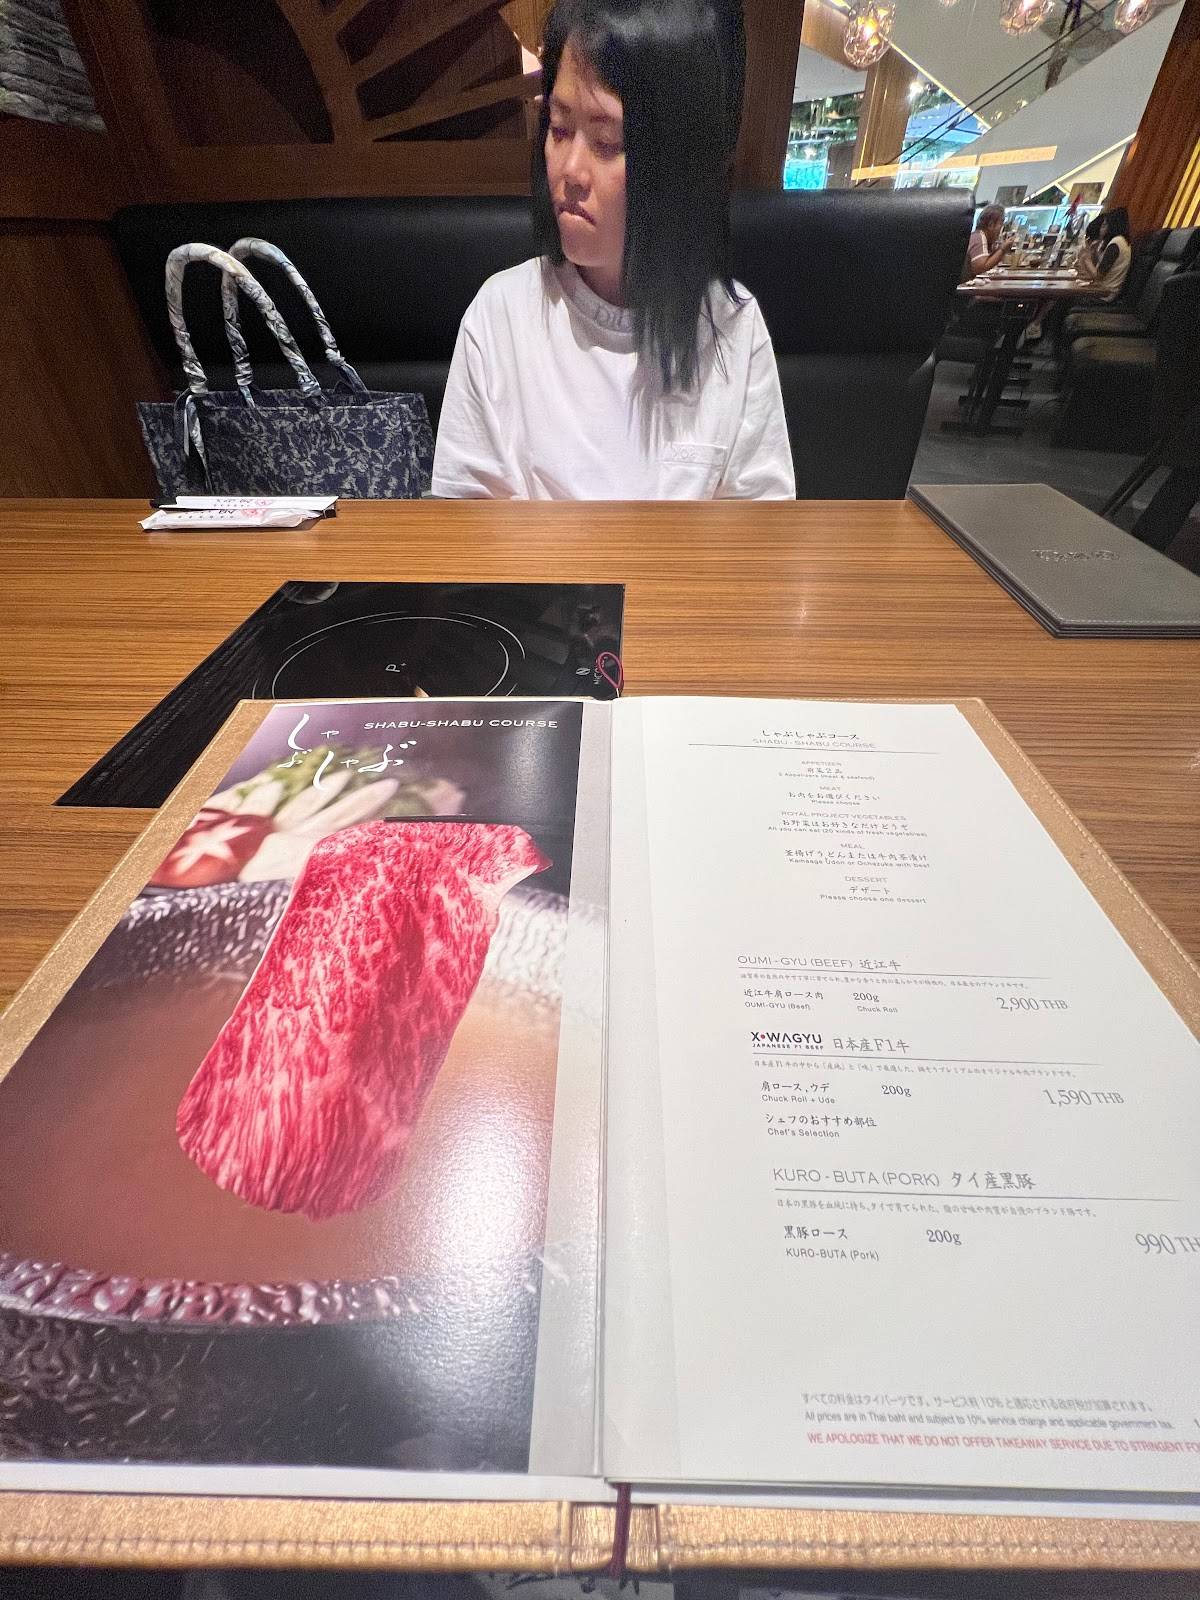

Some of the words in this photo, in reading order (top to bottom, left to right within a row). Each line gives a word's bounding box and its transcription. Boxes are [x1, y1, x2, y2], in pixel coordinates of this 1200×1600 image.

[364, 719, 484, 730] SHABU-SHABU
[489, 719, 558, 729] COURSE
[762, 729, 861, 740] しゃぶしゃぶコース
[850, 813, 907, 821] VEGETABLES
[845, 875, 888, 883] DESSERT
[849, 886, 891, 894] デザート
[819, 893, 847, 901] Please
[896, 896, 928, 904] dessert
[811, 958, 853, 969] (BEEF)
[859, 959, 902, 971] 近江牛
[743, 987, 825, 1000] 近江牛肩ロース肉
[853, 992, 880, 1003] 200g
[744, 1001, 786, 1009] OUMI-GYU
[788, 1003, 811, 1011] (Beef)
[857, 1005, 881, 1013] Chuck
[996, 997, 1039, 1012] 2,900
[1039, 999, 1069, 1010] THB
[832, 1037, 910, 1053] 日本産F1牛
[881, 1085, 912, 1097] 200g
[761, 1094, 788, 1102] Chuck
[1043, 1089, 1092, 1107] 1,590
[1092, 1092, 1125, 1104] THB
[765, 1113, 878, 1128] シェフのおすすめ部位
[767, 1128, 796, 1137] Chef's
[799, 1129, 840, 1138] Selection
[882, 1172, 940, 1187] (PORK)
[951, 1171, 1036, 1190] タイ産黒豚
[784, 1225, 848, 1240] 黒豚ロース
[926, 1229, 962, 1246] 200g
[1135, 1233, 1176, 1255] 990
[785, 1248, 847, 1260] KURO-BUTA
[850, 1250, 879, 1261] (Pork)
[806, 1410, 815, 1421] All
[816, 1412, 841, 1423] prices
[843, 1412, 857, 1422] are
[867, 1411, 886, 1422] Thai
[887, 1413, 906, 1423] baht
[907, 1413, 924, 1424] and
[925, 1414, 956, 1426] subject
[966, 1414, 986, 1425] 10%
[987, 1416, 1017, 1426] service
[1017, 1416, 1047, 1429] charge
[1048, 1418, 1065, 1427] and
[807, 1433, 824, 1445] WE
[825, 1433, 880, 1446] APOLOGIZE
[880, 1433, 906, 1446] THAT
[906, 1434, 923, 1447] WE
[923, 1435, 941, 1447] DO
[940, 1436, 961, 1447] NOT
[961, 1436, 995, 1449] OFFER
[995, 1438, 1047, 1450] TAKEAWAY
[1048, 1439, 1093, 1451] SERVICE
[1091, 1440, 1115, 1451] DUE
[1114, 1440, 1129, 1452] TO
